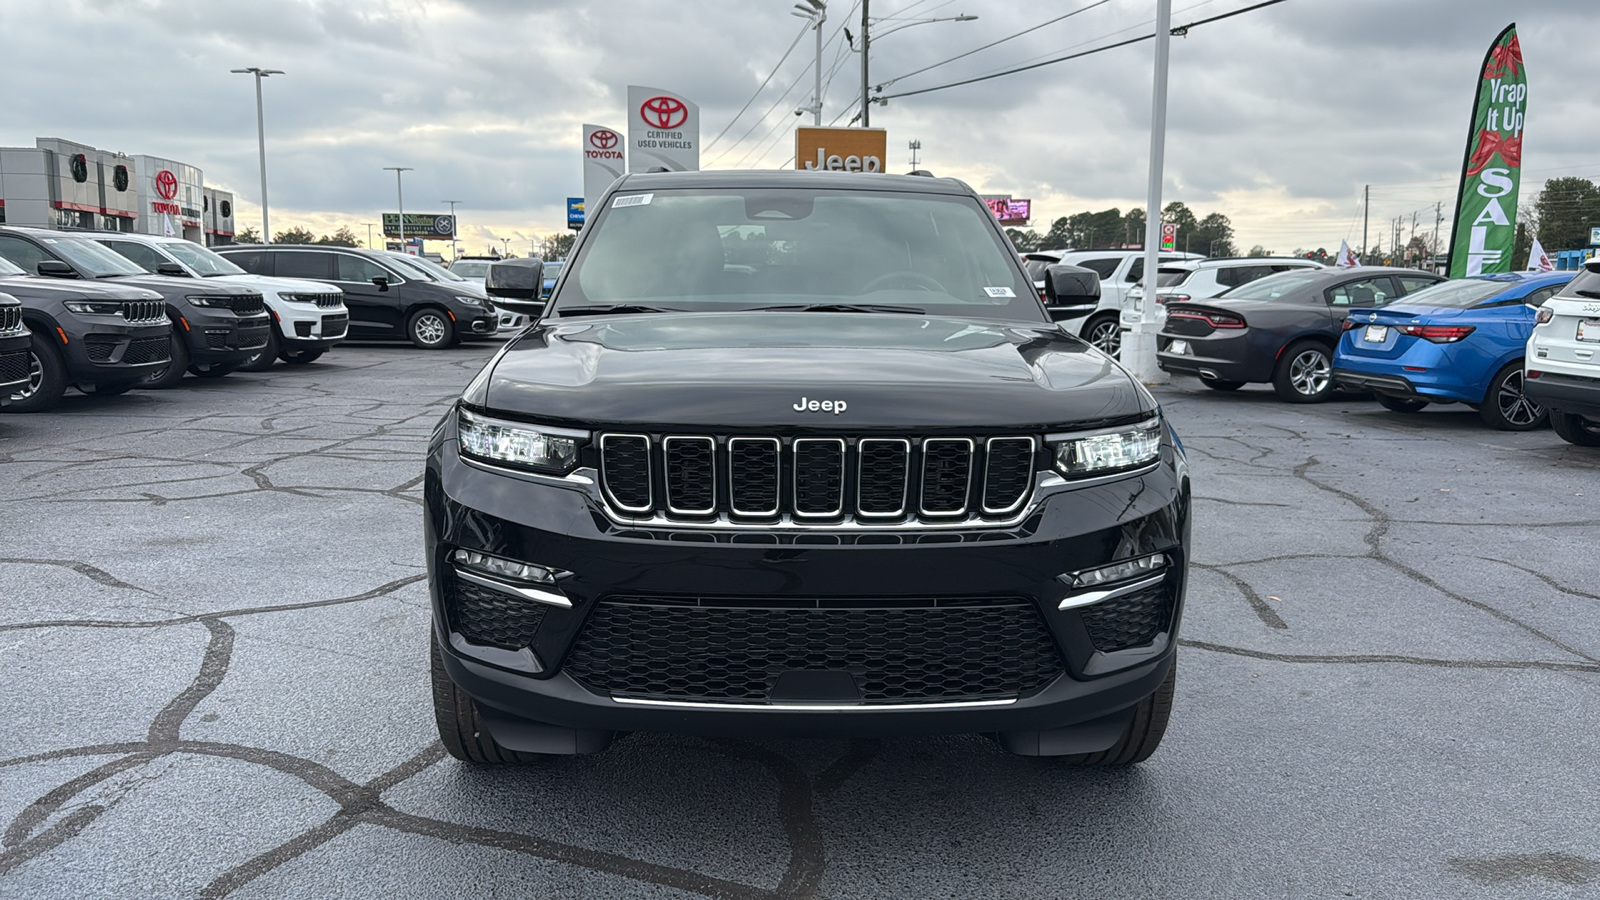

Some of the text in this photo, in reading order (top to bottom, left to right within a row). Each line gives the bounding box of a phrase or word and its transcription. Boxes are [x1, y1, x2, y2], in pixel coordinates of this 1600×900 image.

[1486, 106, 1524, 138] It Up
[647, 130, 682, 140] CERTIFIED
[637, 140, 692, 149] USED VEHICLES
[585, 150, 623, 159] TOYOTA
[804, 147, 881, 172] Jeep
[152, 201, 181, 215] TOYOTA
[792, 396, 847, 415] Jeep
